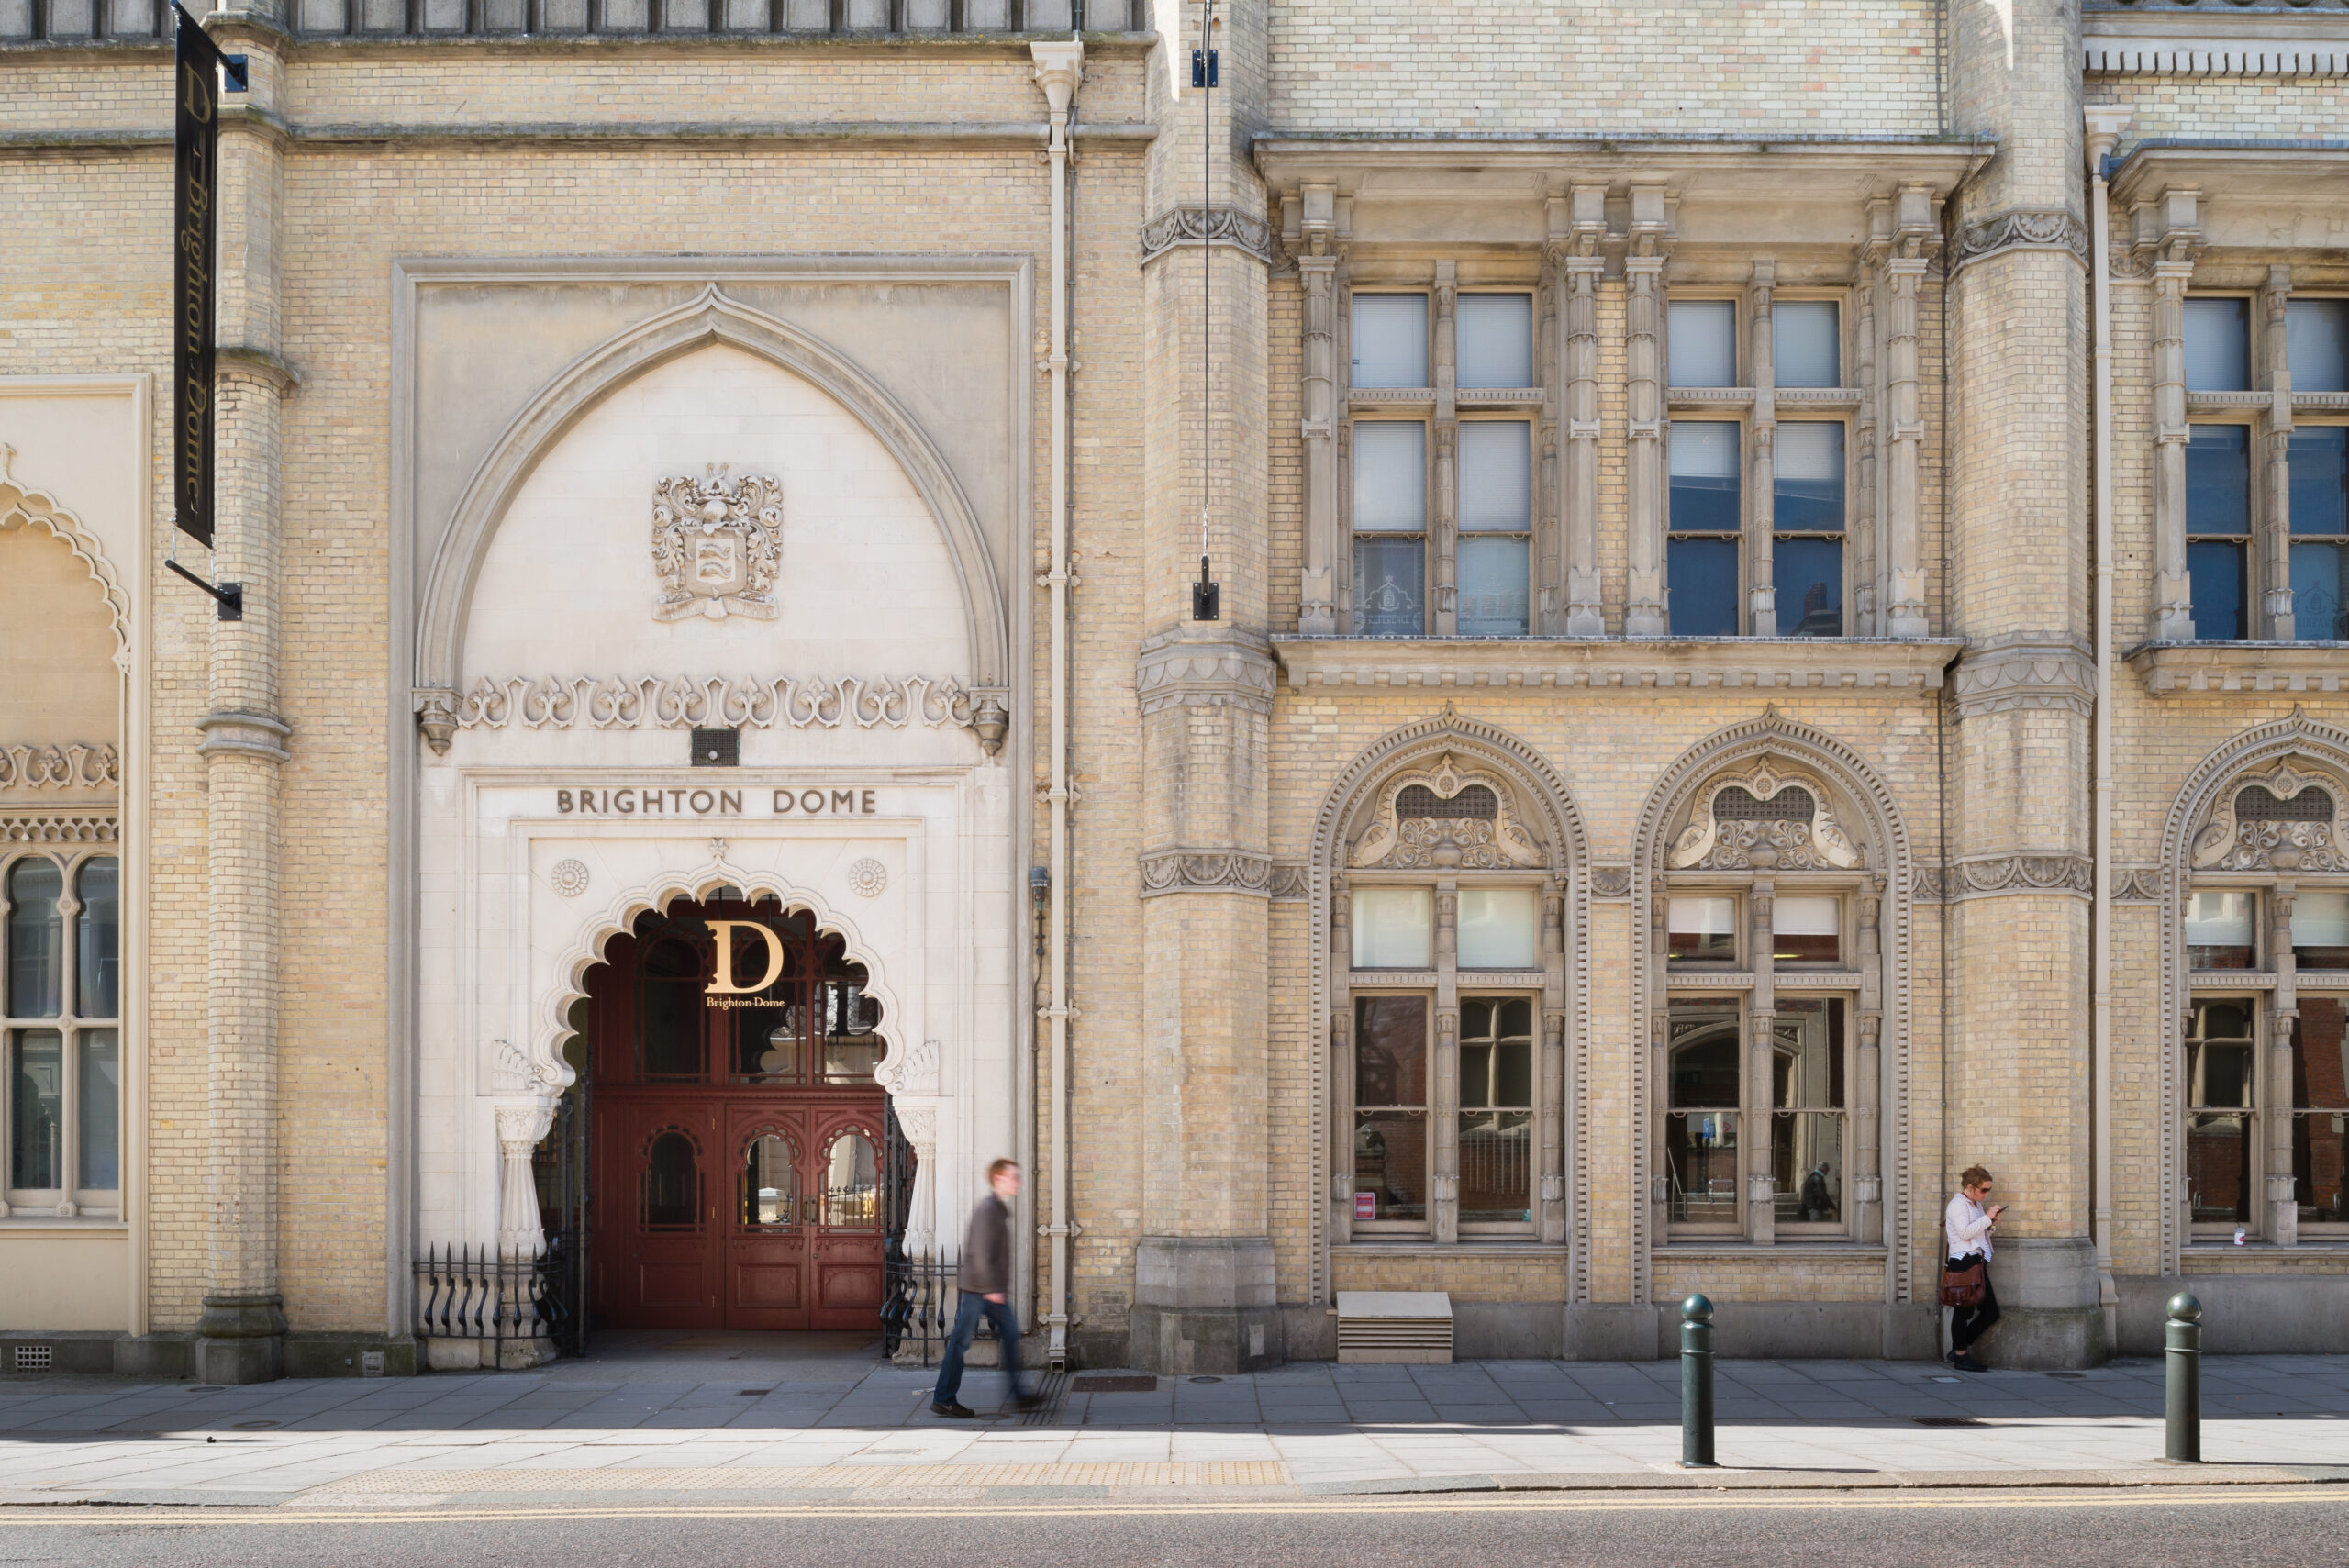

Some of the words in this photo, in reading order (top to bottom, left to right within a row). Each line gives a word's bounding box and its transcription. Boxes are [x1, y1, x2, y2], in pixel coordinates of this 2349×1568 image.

[184, 61, 211, 124] D
[181, 172, 208, 355] Brighton
[187, 374, 206, 500] Dome
[556, 789, 742, 814] BRIGHTON
[773, 789, 876, 814] DOME
[704, 920, 785, 994] D
[706, 996, 752, 1011] Brighton
[753, 996, 785, 1007] Dome
